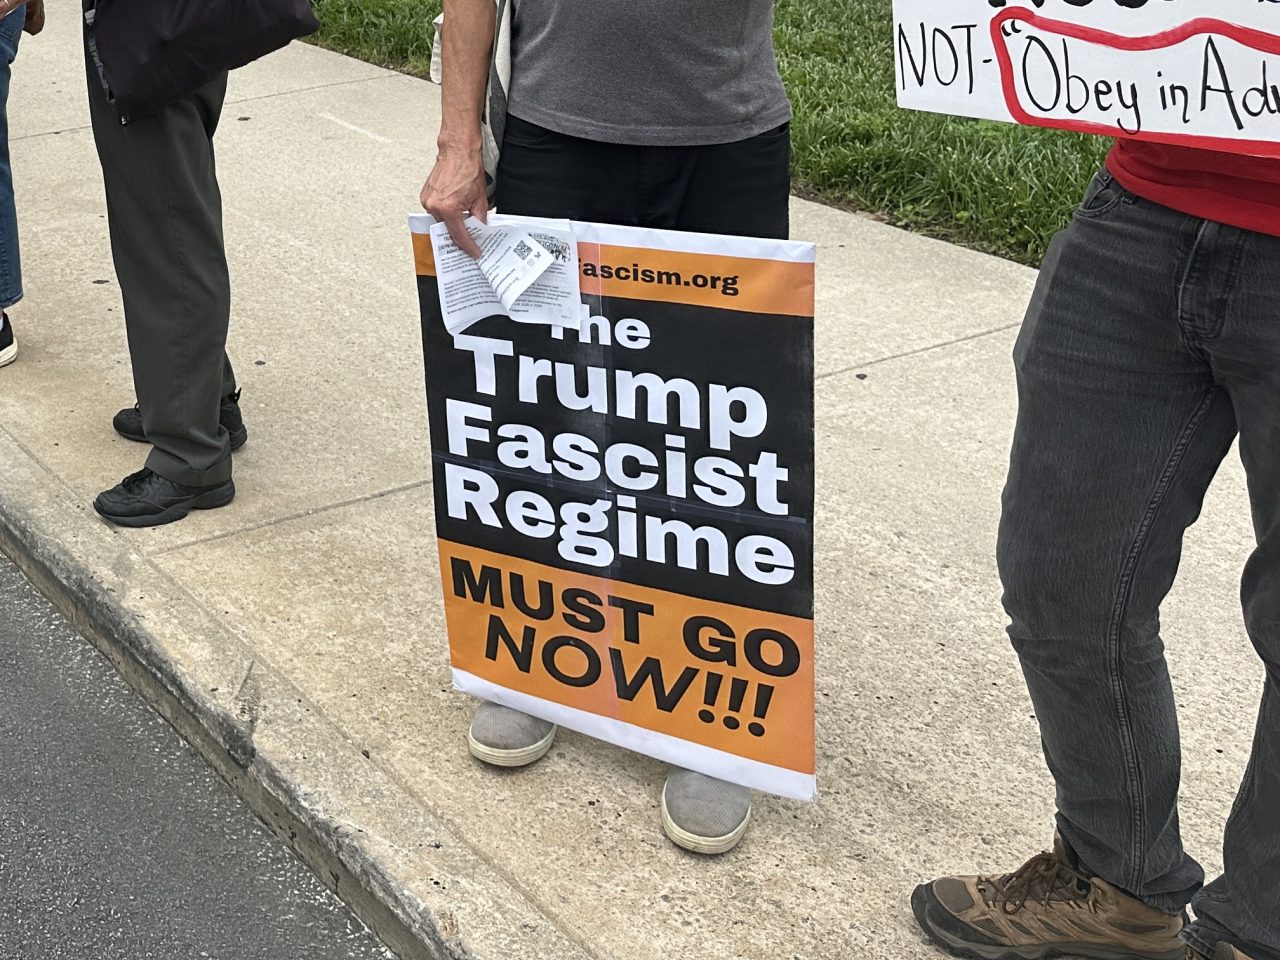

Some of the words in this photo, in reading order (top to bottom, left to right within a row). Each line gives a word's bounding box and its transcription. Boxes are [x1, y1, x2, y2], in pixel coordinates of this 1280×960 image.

[1157, 71, 1191, 123] in
[551, 303, 651, 349] he
[453, 334, 769, 451] Trump
[445, 397, 789, 515] Fascist
[444, 463, 795, 586] Regime
[450, 556, 654, 645] MUST
[682, 615, 801, 677] GO
[485, 614, 775, 738] NOW!!!
